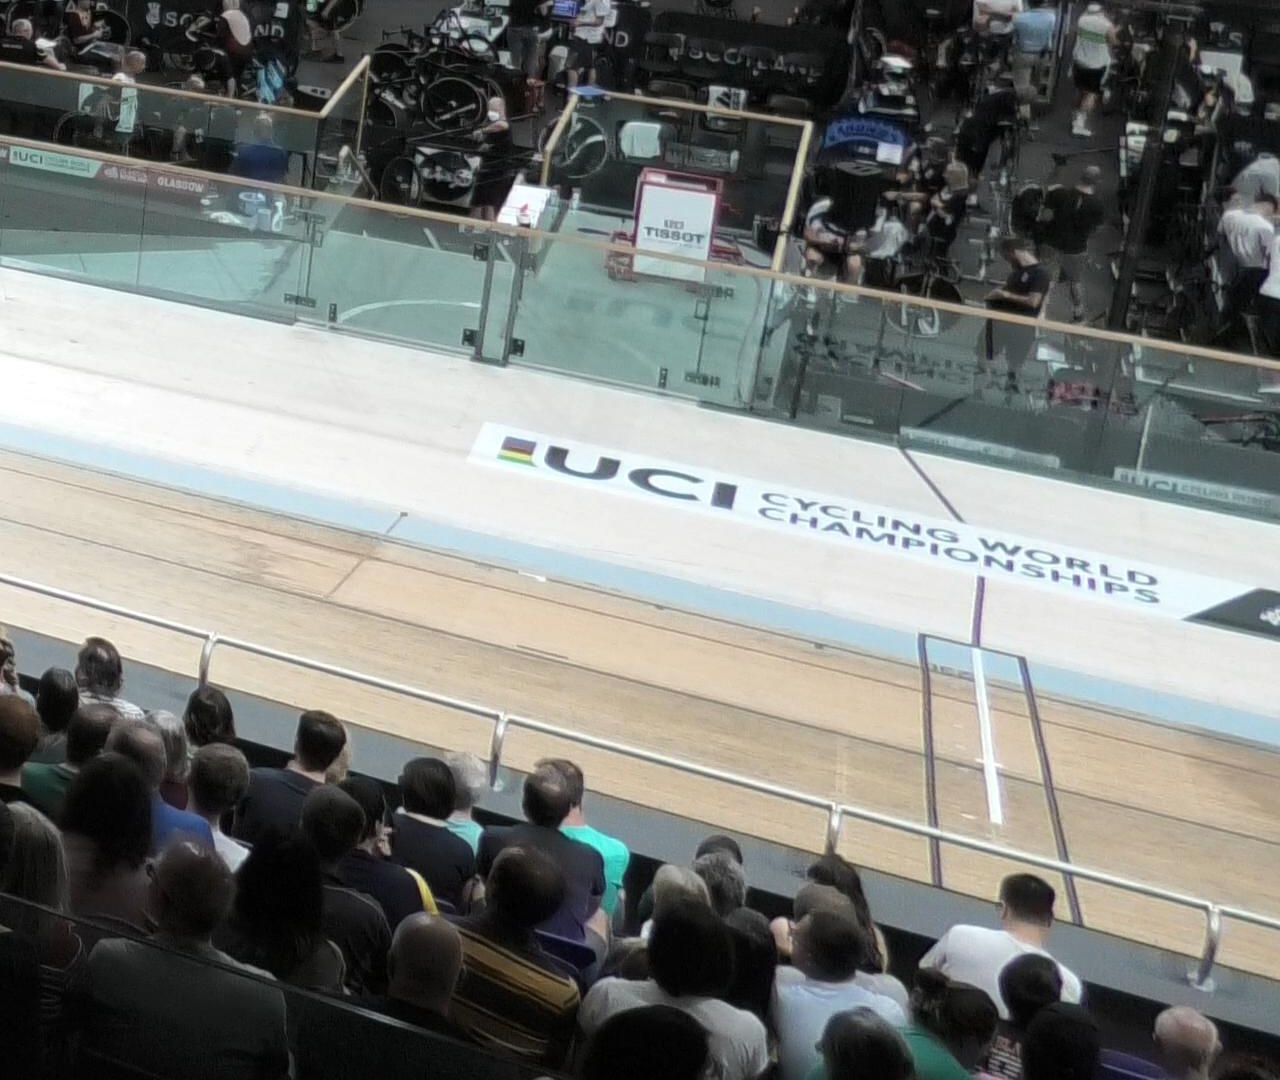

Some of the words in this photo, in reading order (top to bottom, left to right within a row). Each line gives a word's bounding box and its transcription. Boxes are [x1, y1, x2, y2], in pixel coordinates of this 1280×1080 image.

[17, 151, 43, 164] UCI
[157, 176, 205, 192] GLASGOW
[644, 226, 706, 245] TISSOT
[543, 445, 739, 510] UCI
[757, 506, 1162, 605] CHAMPIONSHIPS
[759, 492, 960, 544] CYCLING
[978, 536, 1162, 588] WORLD
